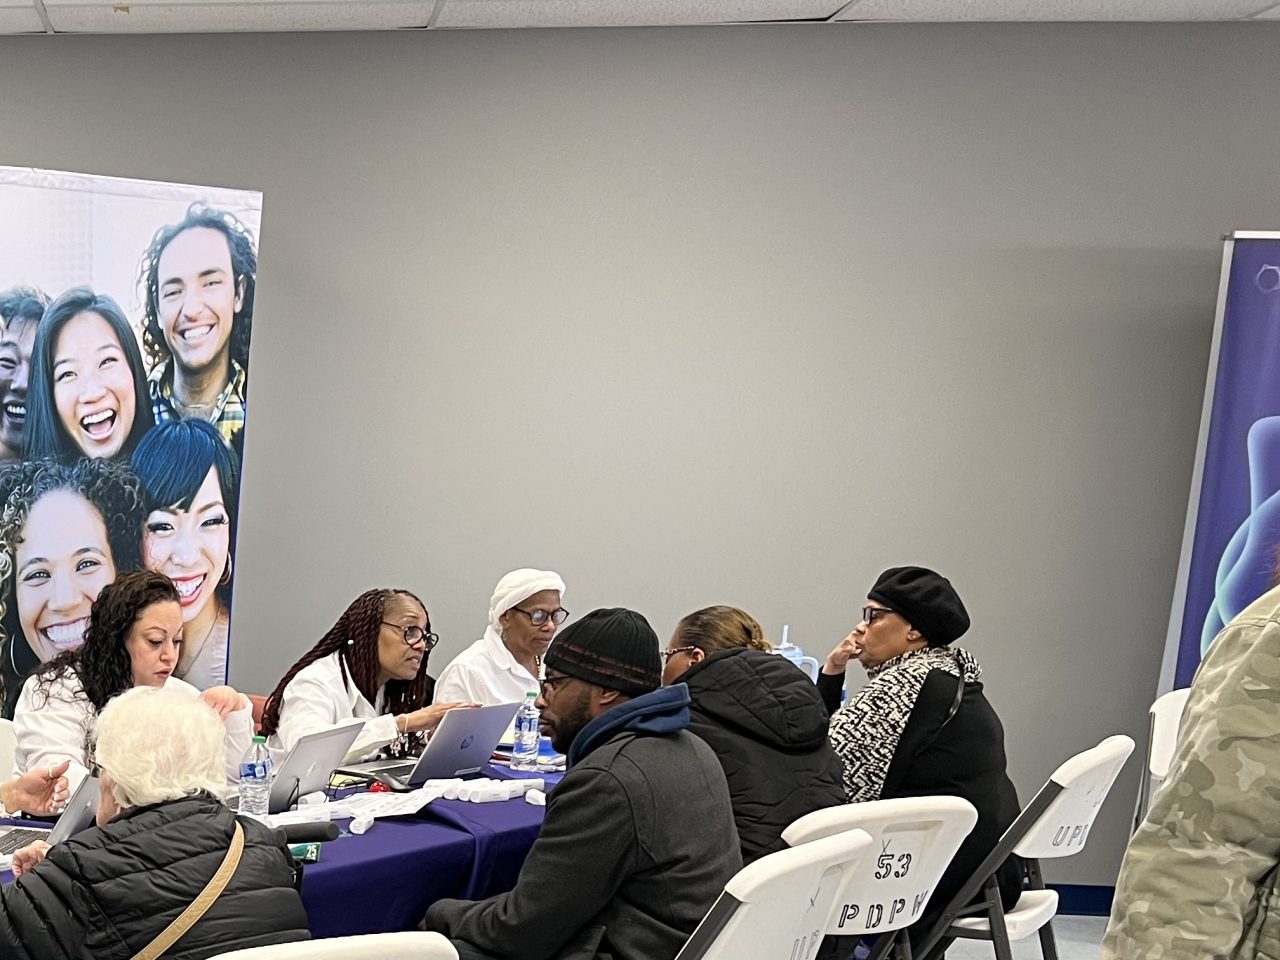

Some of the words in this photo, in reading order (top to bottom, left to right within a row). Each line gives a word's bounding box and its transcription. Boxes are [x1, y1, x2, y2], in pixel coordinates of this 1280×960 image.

[306, 844, 317, 860] 25
[874, 853, 912, 880] 53
[837, 890, 929, 930] PDPW
